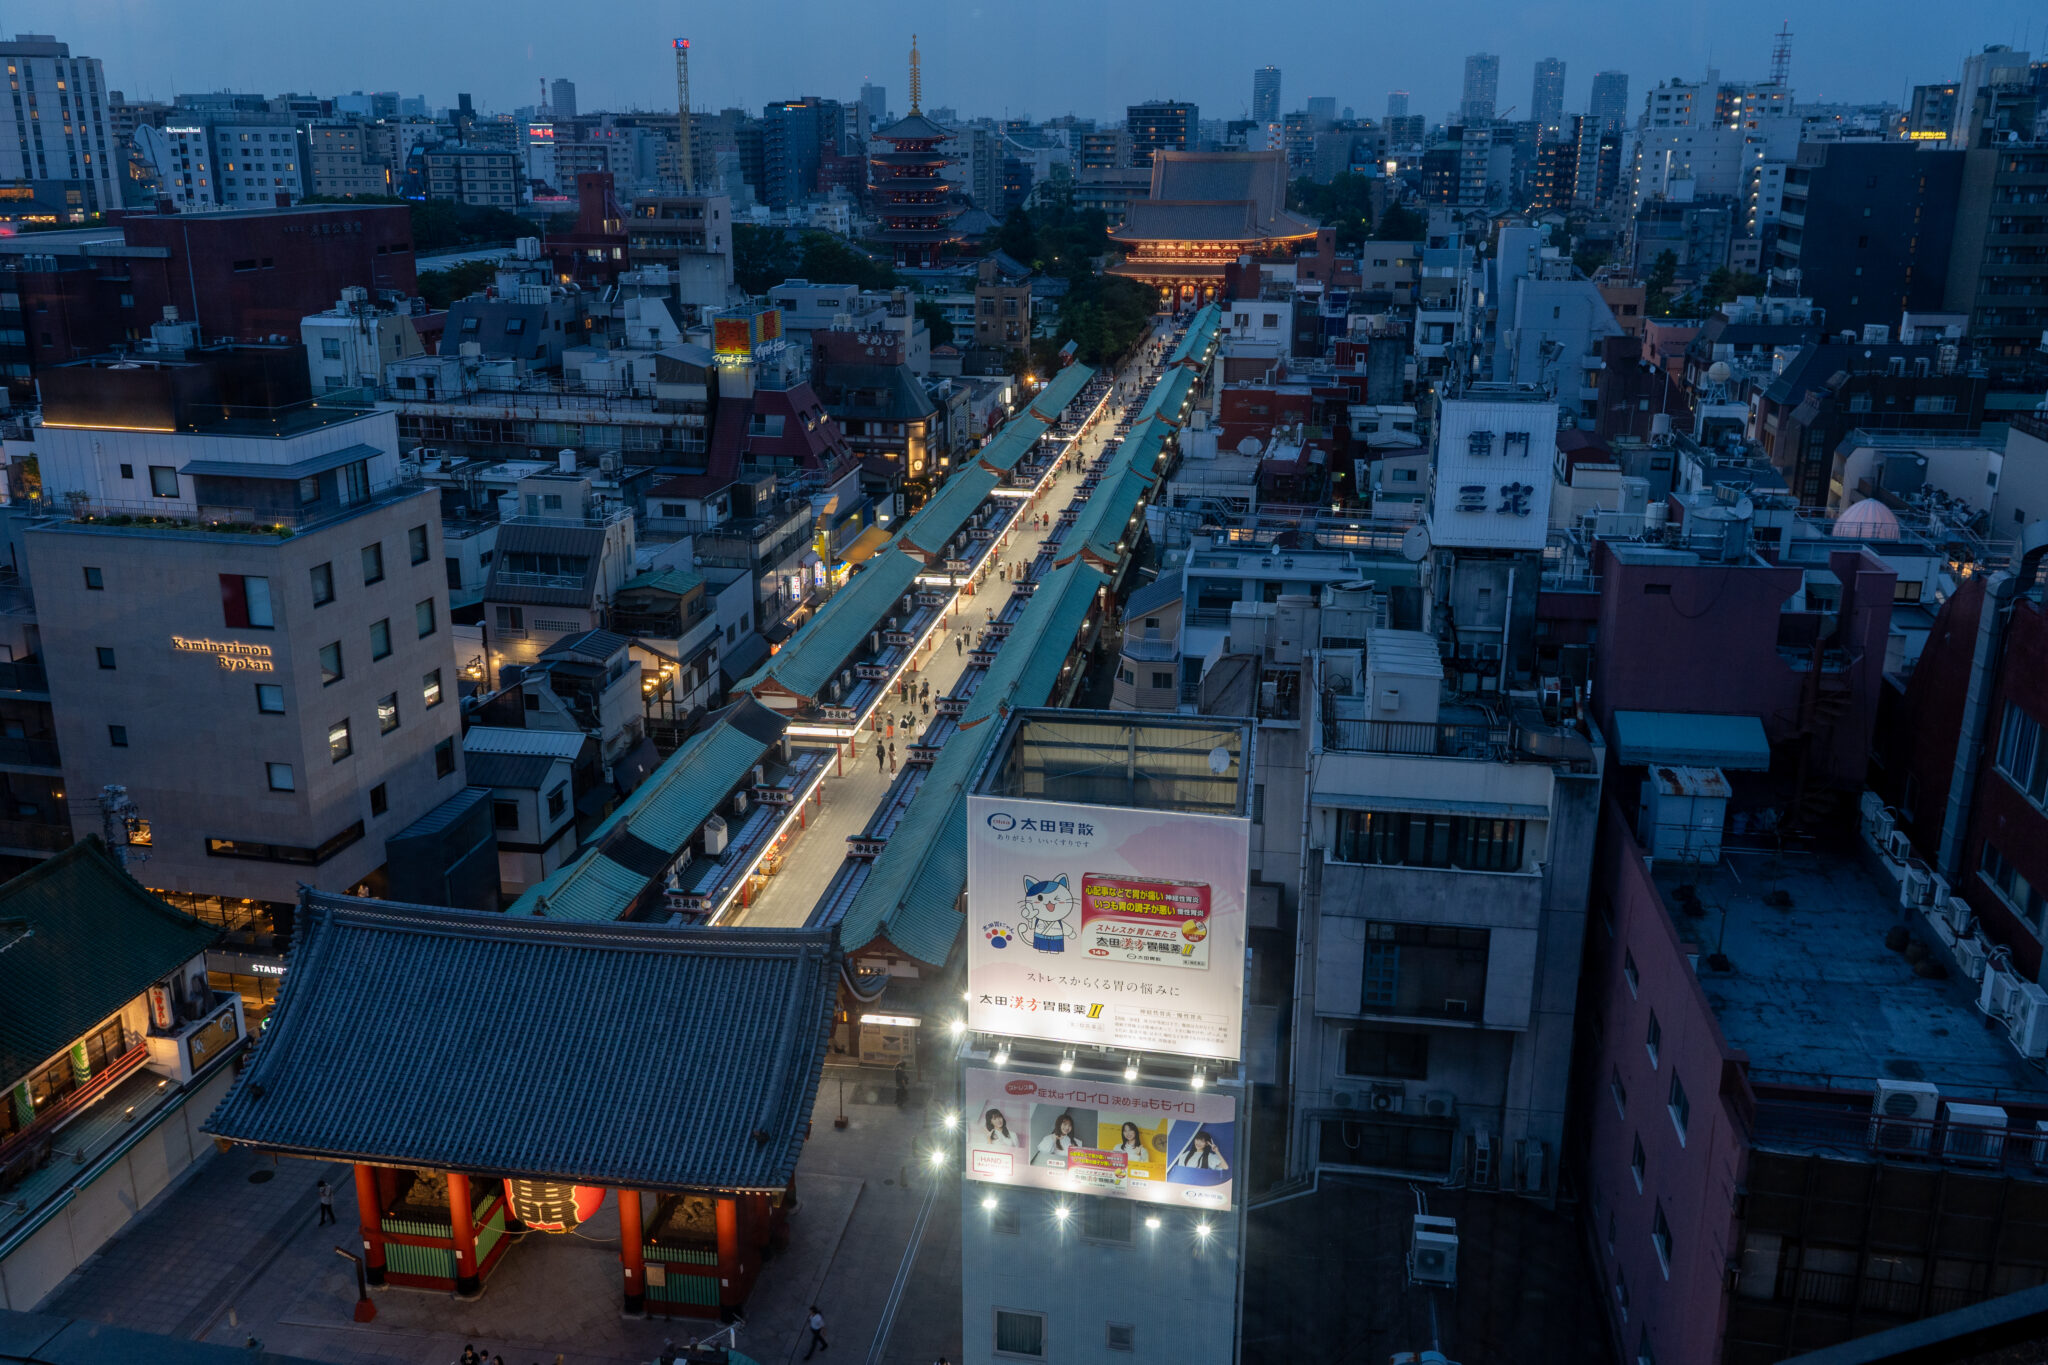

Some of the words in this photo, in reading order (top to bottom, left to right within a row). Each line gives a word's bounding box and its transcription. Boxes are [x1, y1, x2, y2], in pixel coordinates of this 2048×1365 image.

[1467, 430, 1531, 458] 雷門
[171, 637, 271, 656] Kaminarimon
[217, 655, 272, 672] Ryokan
[1020, 818, 1095, 837] 太田胃散
[997, 833, 1033, 843] ありがとう
[1038, 838, 1090, 848] いいくすりです
[1085, 885, 1164, 902] 心配事などで胃が痛い
[1094, 900, 1176, 916] いつも胃の調子が悪い
[252, 964, 287, 975] STARB
[1026, 972, 1180, 997] ストレスからくる胃の悩みに
[1037, 1088, 1109, 1105] 症状はイロイロ
[1111, 1095, 1196, 1114] 決め手はももイロ
